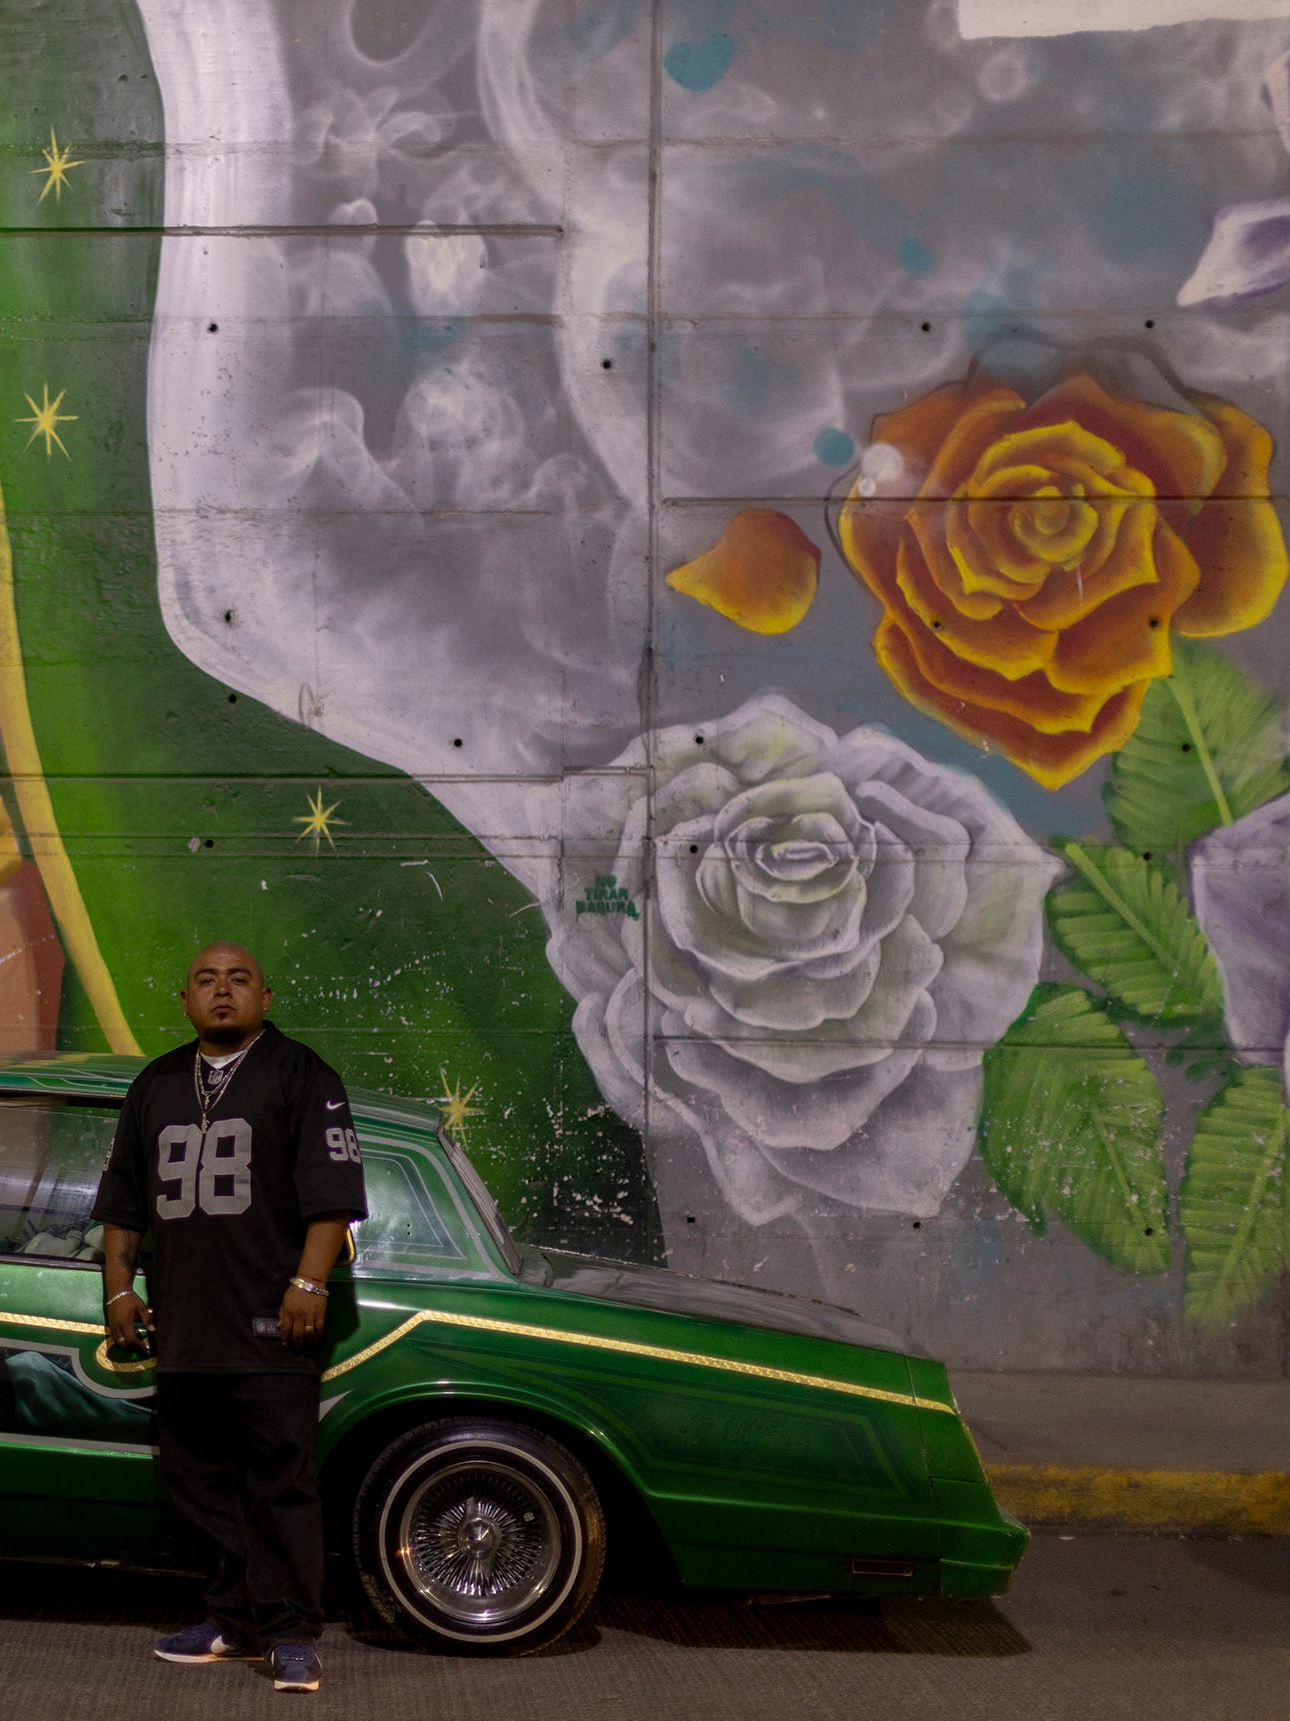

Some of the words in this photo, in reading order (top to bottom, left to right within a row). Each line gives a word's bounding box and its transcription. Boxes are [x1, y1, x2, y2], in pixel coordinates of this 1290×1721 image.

[584, 887, 629, 901] TIRAR
[575, 900, 640, 920] BASURA
[326, 1127, 361, 1164] 98
[157, 1118, 253, 1220] 98
